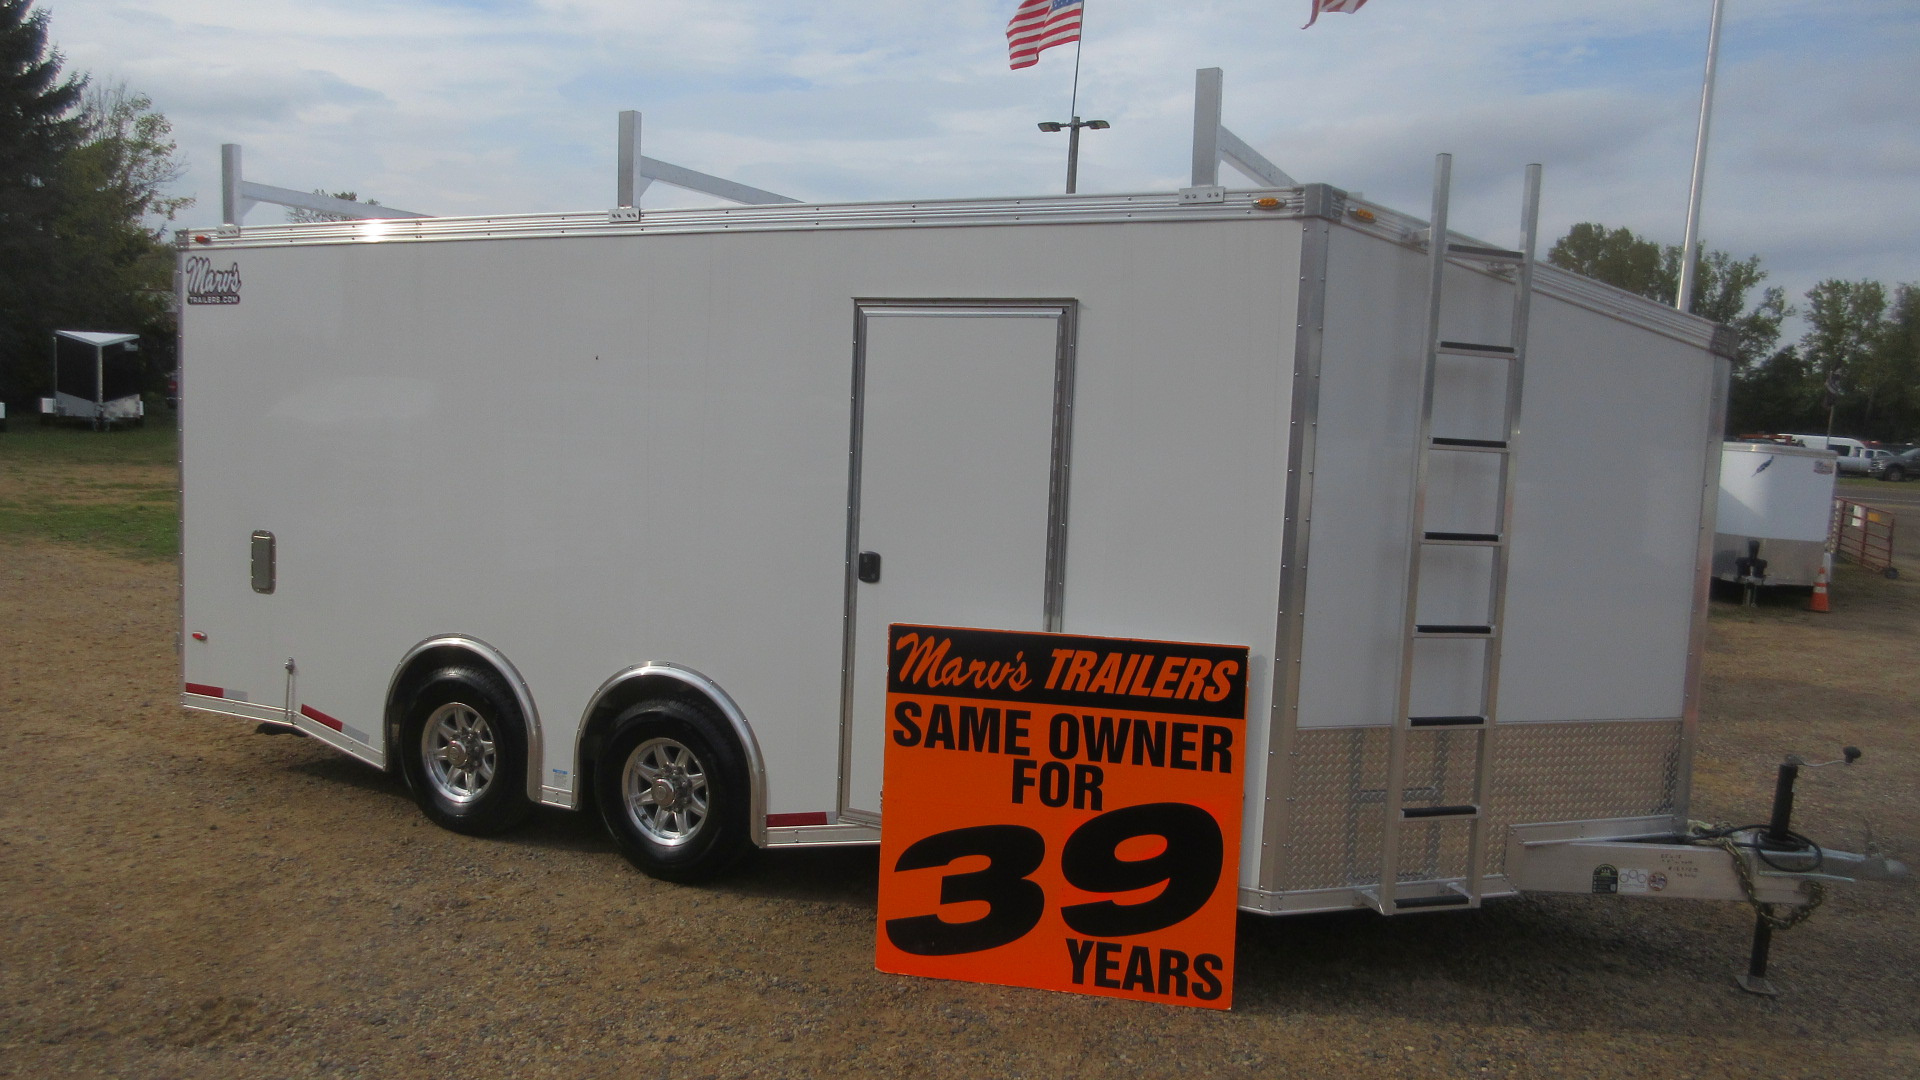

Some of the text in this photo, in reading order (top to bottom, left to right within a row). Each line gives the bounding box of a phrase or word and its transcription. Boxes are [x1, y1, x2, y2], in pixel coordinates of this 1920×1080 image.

[186, 256, 241, 294] Marv's
[188, 296, 239, 304] TRAILERS.COM
[895, 632, 1239, 702] Marv's TRAILERS
[893, 701, 1234, 774] SAME OWNER
[1011, 759, 1105, 811] FOR
[885, 802, 1224, 956] 39
[1065, 938, 1224, 1001] YEARS
